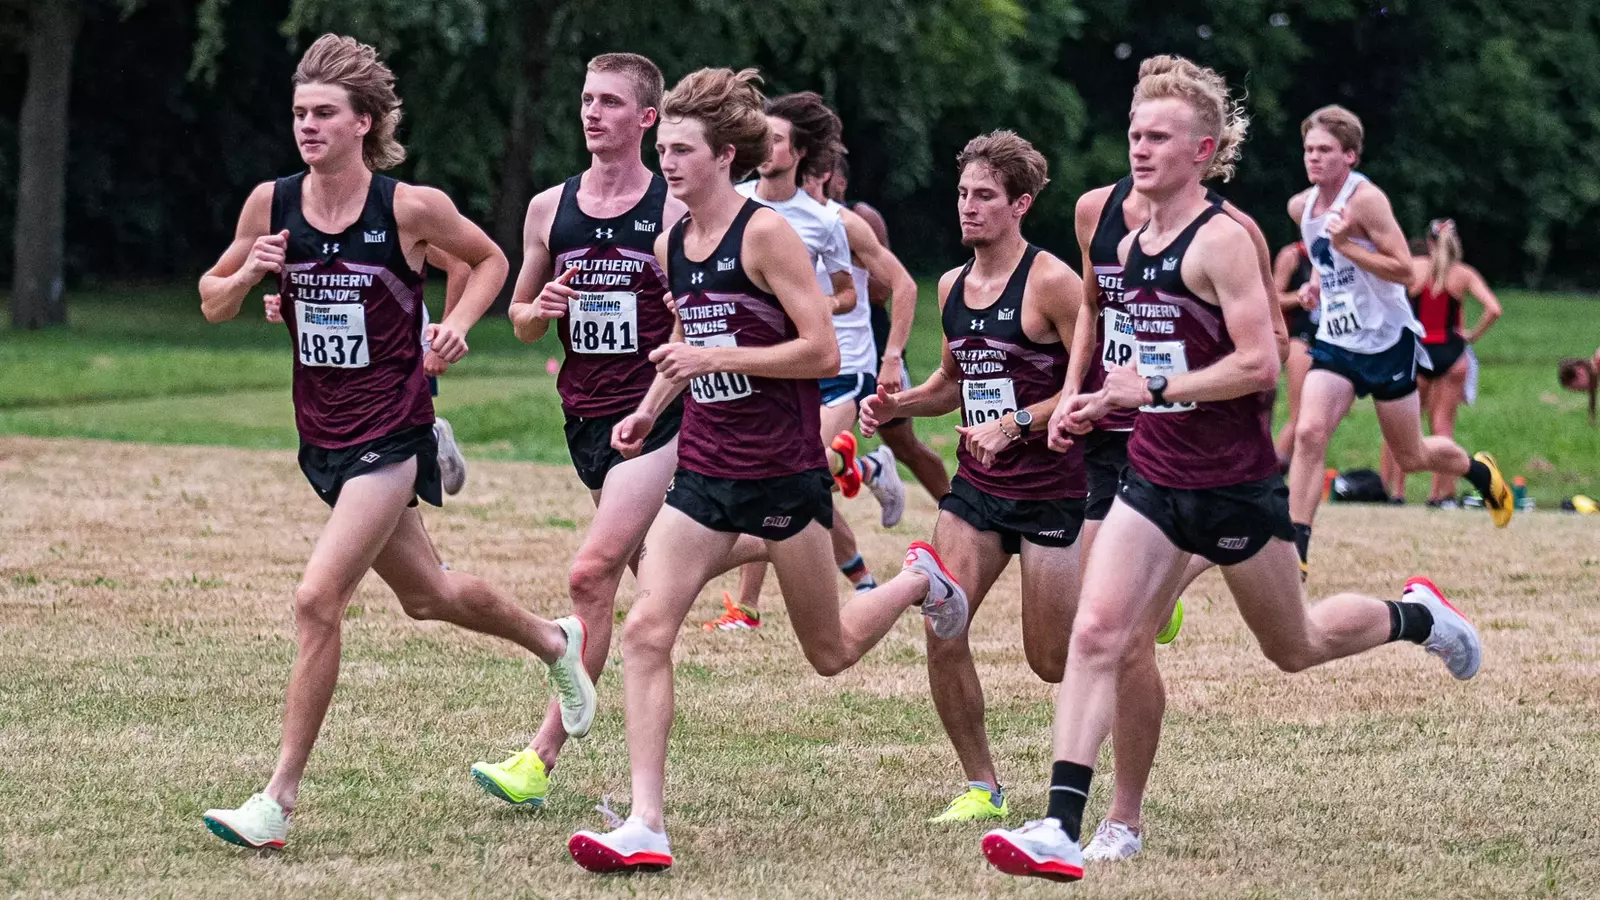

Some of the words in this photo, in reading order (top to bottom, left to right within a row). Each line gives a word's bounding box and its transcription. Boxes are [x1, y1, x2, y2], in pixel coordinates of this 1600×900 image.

[290, 272, 373, 287] SOUTHERN
[298, 287, 360, 301] ILLINOIS
[305, 311, 348, 325] RUNNING
[572, 320, 636, 350] 4841
[301, 332, 364, 365] 4837
[692, 371, 748, 399] 4840
